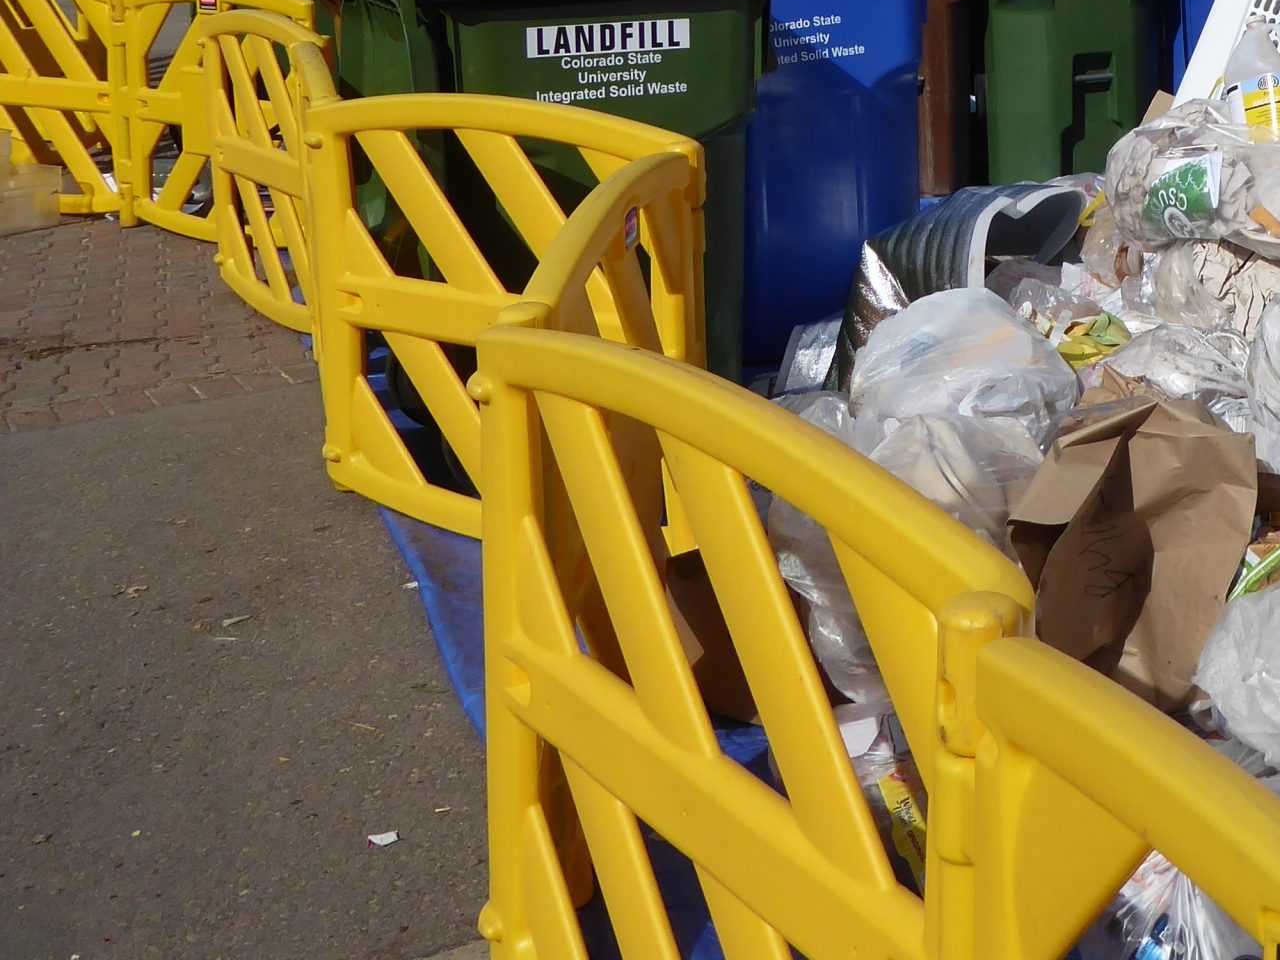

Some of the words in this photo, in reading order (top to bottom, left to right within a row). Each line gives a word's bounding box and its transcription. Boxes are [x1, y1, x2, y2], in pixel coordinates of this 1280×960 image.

[769, 18, 810, 33] olorado
[812, 15, 842, 27] State
[536, 20, 681, 56] LANDFILL
[774, 31, 830, 48] University
[561, 53, 624, 69] Colorado
[627, 51, 662, 65] State
[800, 47, 829, 61] Solid
[830, 44, 865, 58] Waste
[578, 68, 647, 84] University
[536, 86, 606, 104] Integrated
[609, 84, 644, 98] Solid
[647, 81, 688, 95] Waste
